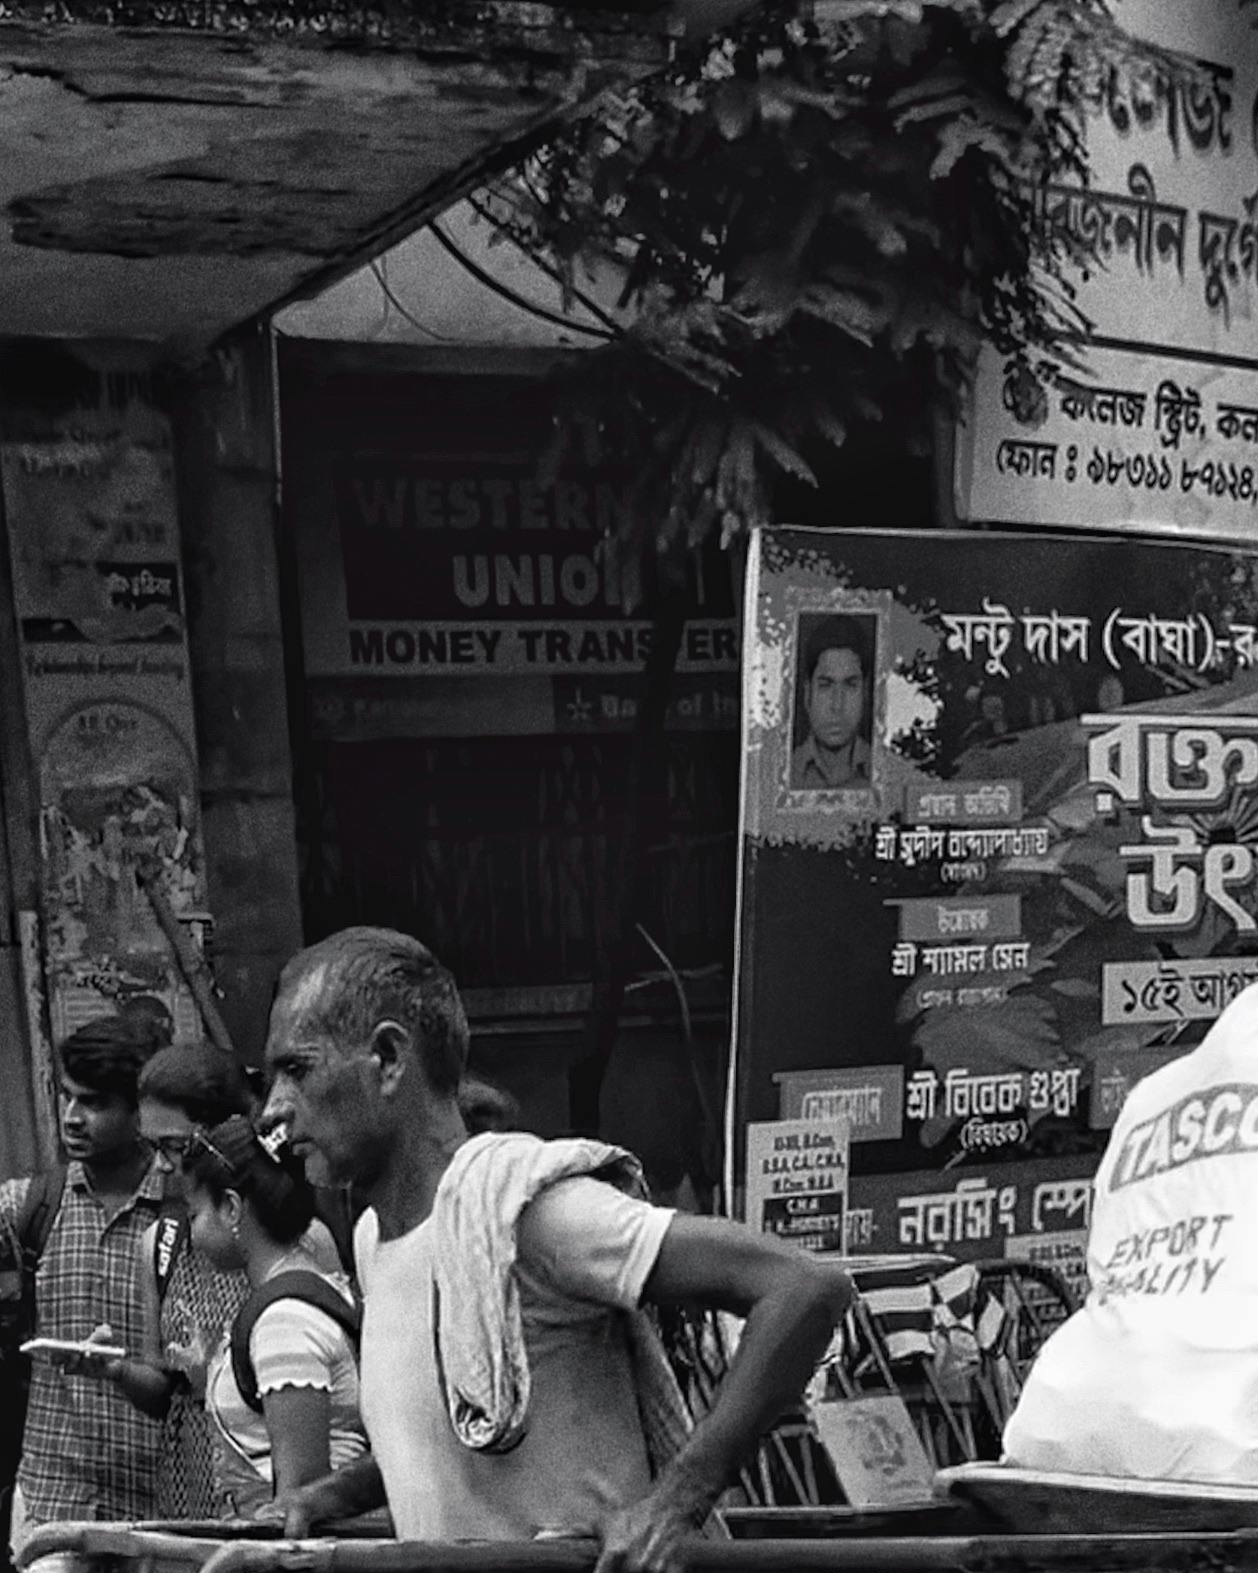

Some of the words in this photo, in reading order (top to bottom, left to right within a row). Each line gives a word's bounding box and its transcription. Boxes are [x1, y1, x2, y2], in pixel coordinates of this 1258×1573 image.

[996, 439, 1058, 481] ফোন
[349, 629, 502, 664] MONEY
[518, 628, 738, 662] TRANSER
[941, 596, 1016, 680] মন্টু
[1020, 609, 1091, 665] দাস
[875, 825, 897, 861] শ্রী
[891, 942, 917, 976] শ্রী
[921, 945, 988, 976] শ্যামল
[992, 942, 1031, 971] সেন
[1121, 961, 1185, 1017] ১৫ই
[906, 1070, 938, 1119] শ্রী
[944, 1068, 1023, 1117] বিবেক
[1107, 1213, 1234, 1270] EXPORT
